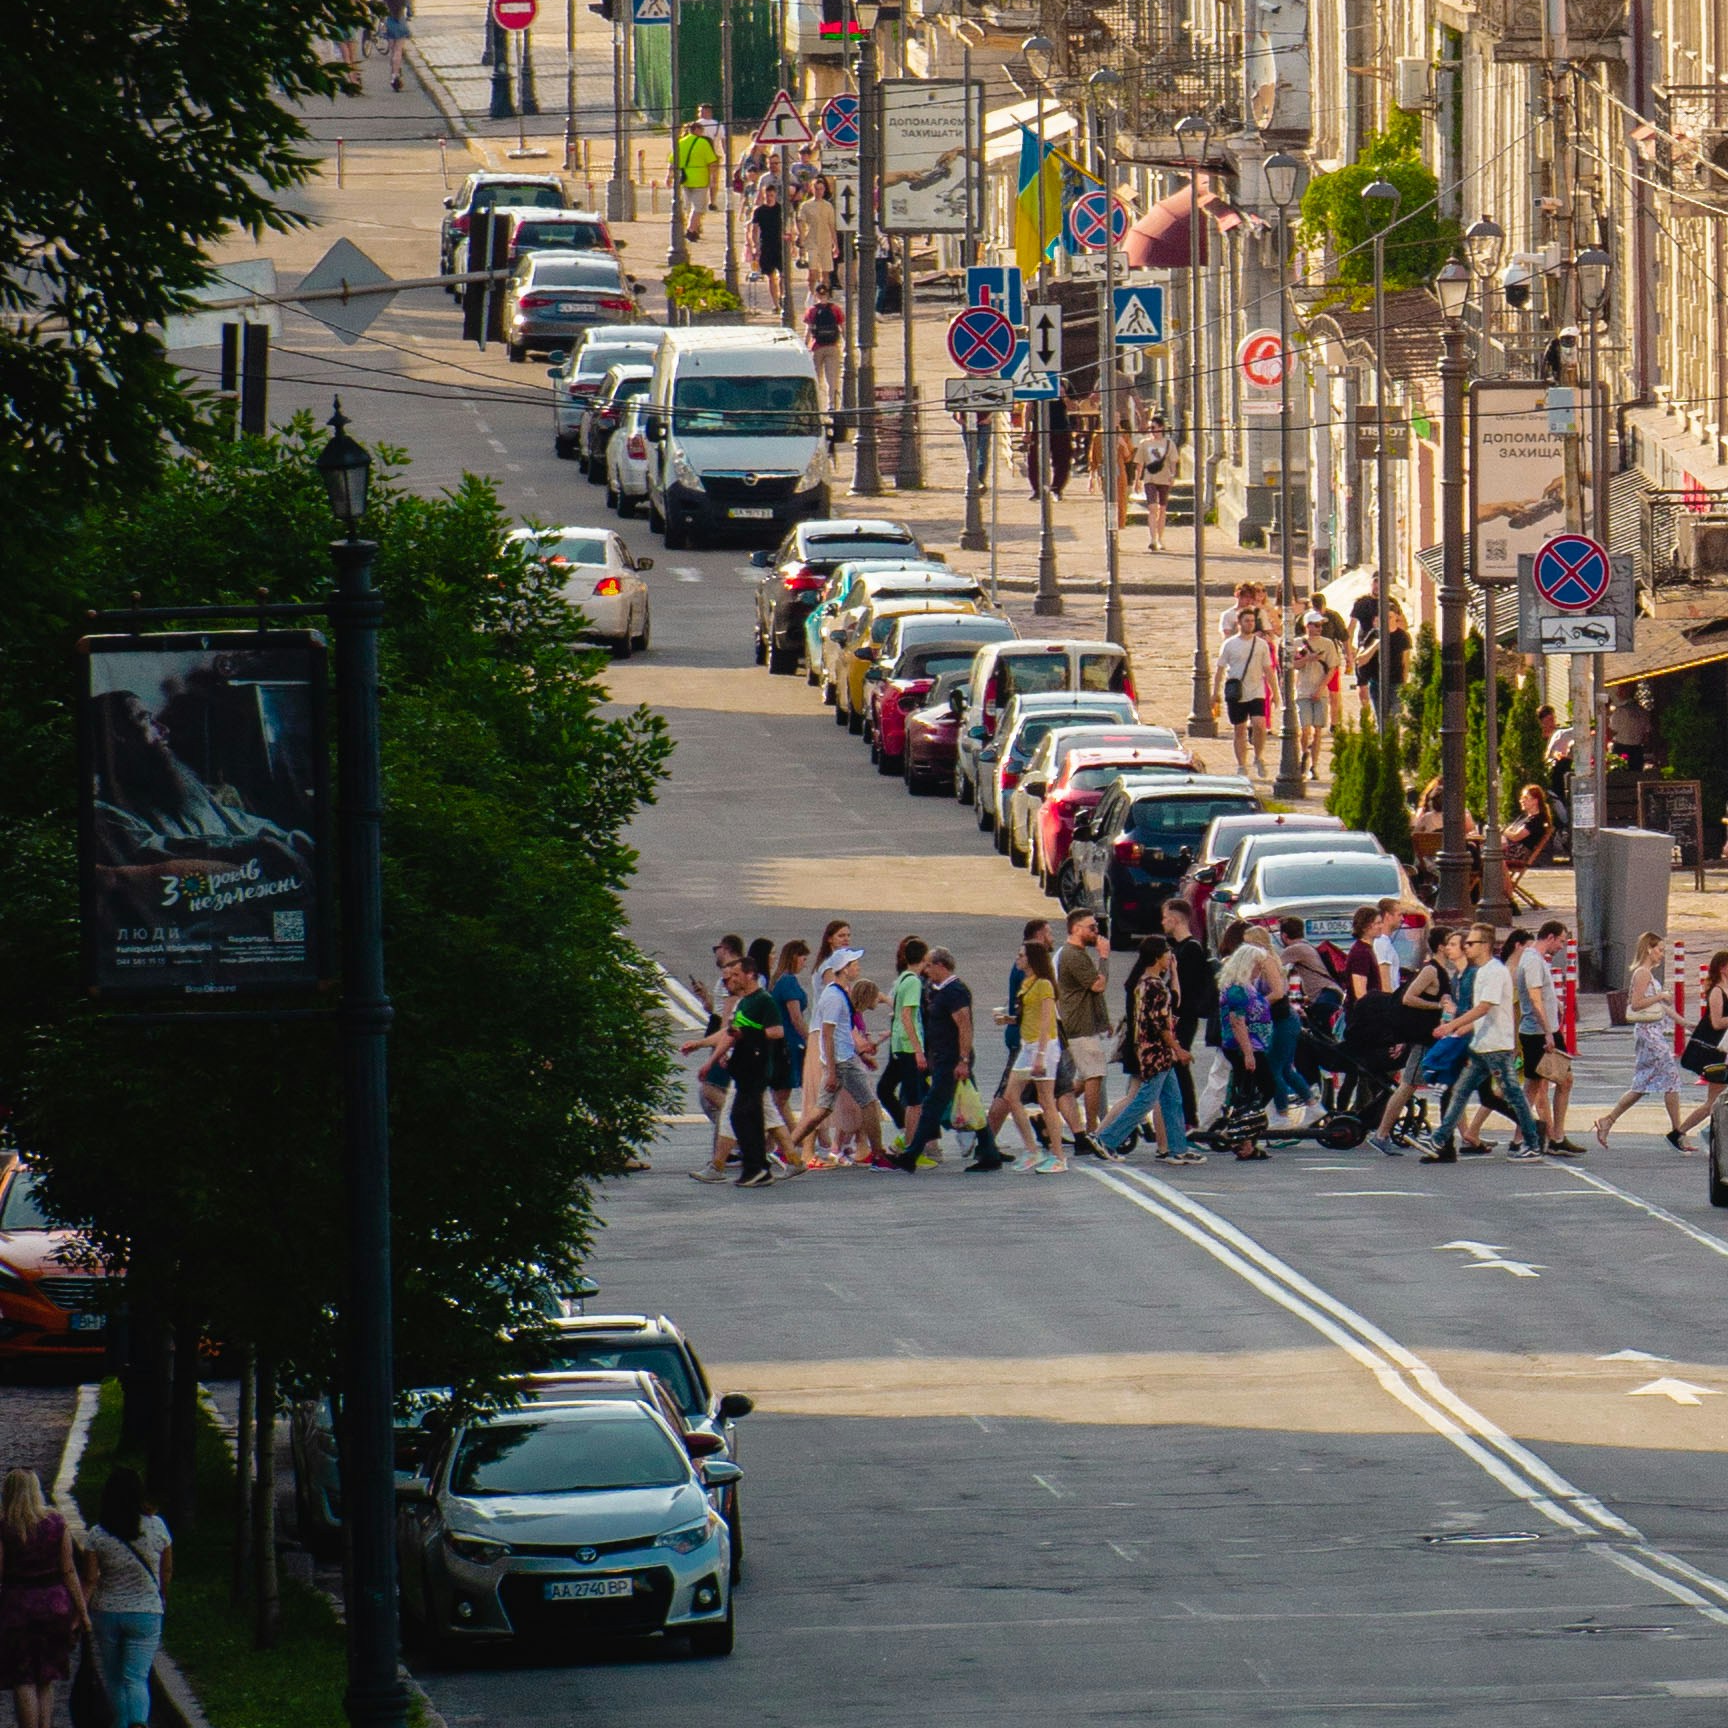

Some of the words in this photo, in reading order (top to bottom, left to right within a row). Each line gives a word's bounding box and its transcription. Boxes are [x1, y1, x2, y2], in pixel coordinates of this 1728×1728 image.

[1360, 427, 1406, 436] TISOT
[1498, 448, 1561, 459] ЗАХИЩА
[208, 858, 262, 896] років
[189, 876, 301, 913] незалежні
[552, 1585, 573, 1598] AA
[575, 1582, 605, 1597] 2740
[608, 1580, 628, 1595] BP
